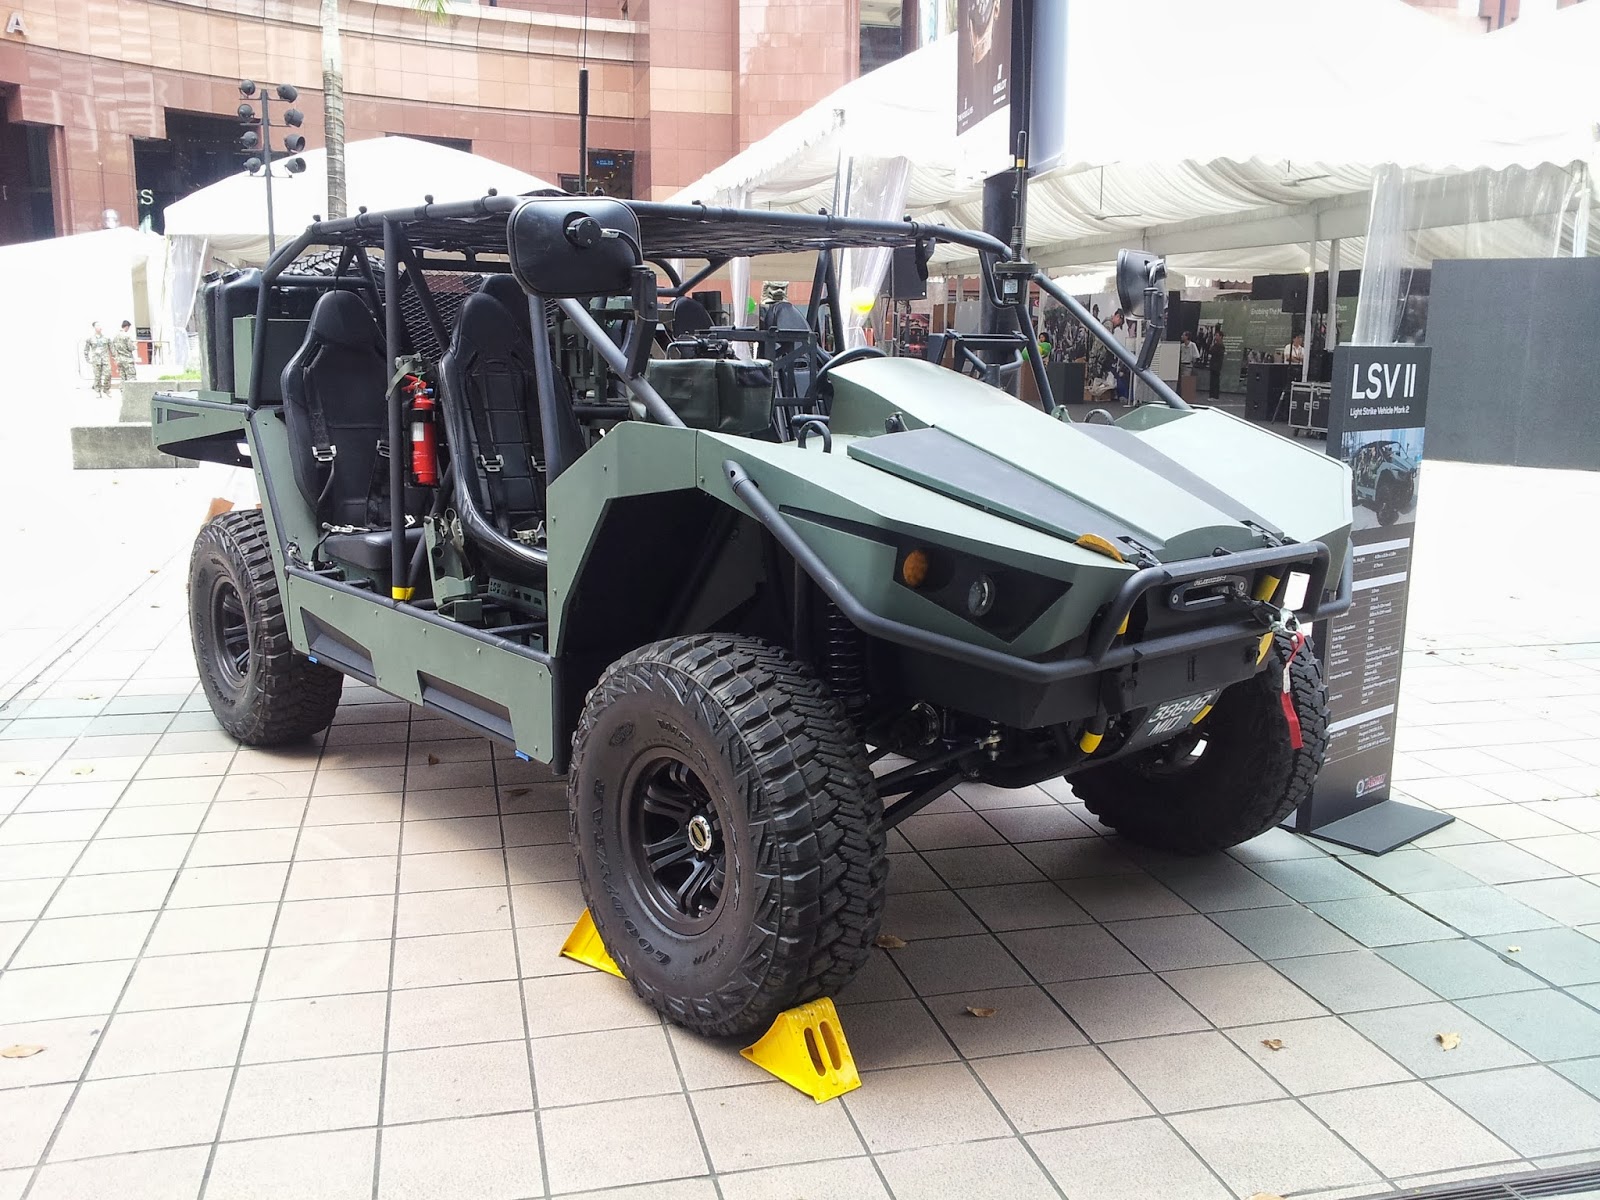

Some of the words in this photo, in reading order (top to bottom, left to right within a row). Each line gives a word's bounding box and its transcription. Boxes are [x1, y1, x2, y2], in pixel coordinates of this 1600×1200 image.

[1351, 362, 1401, 400] LSV
[1349, 407, 1362, 419] Light
[1362, 406, 1377, 416] Strike
[1377, 405, 1393, 415] Vehicle
[1393, 405, 1405, 414] Mark
[1405, 404, 1410, 414] 2
[1148, 715, 1183, 736] MID
